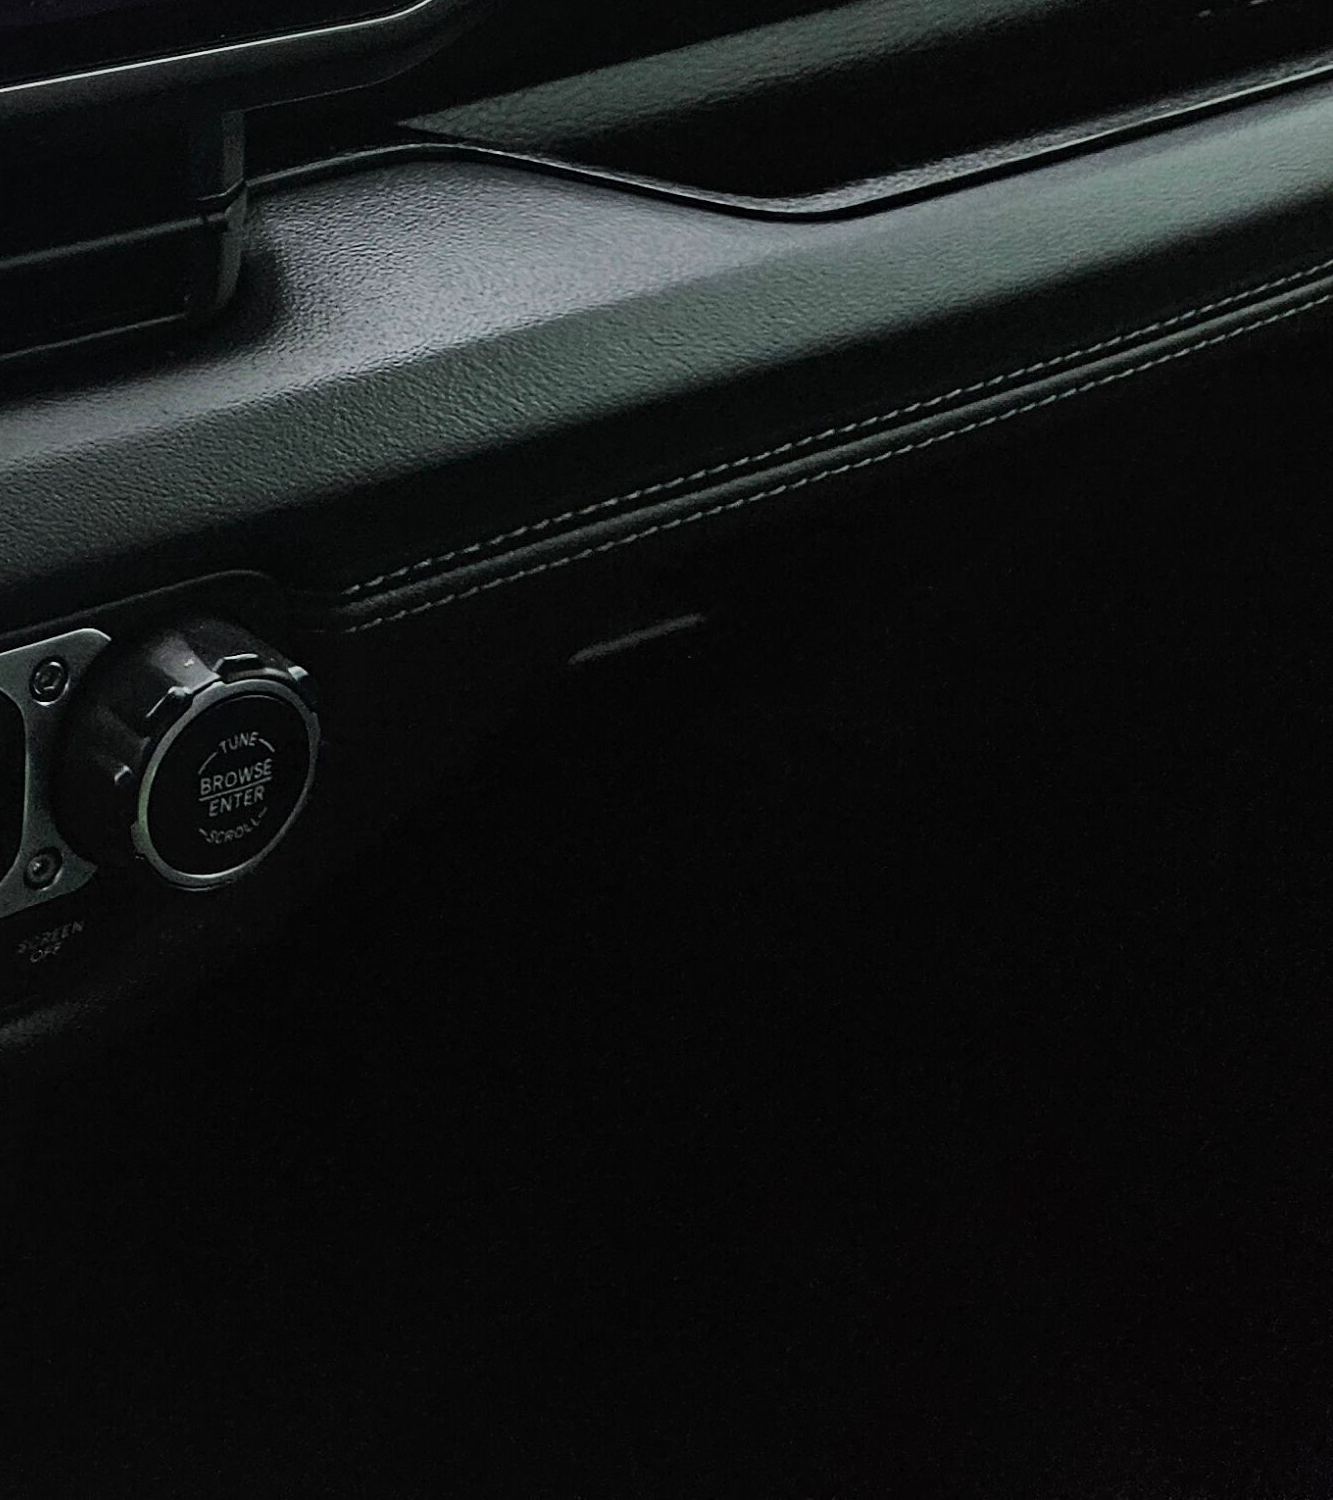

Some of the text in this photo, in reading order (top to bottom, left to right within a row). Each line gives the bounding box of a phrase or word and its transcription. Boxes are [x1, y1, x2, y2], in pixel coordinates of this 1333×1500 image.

[218, 731, 260, 755] TUNE
[199, 757, 274, 797] BROWSE
[208, 785, 266, 817] ENTER
[205, 815, 261, 845] SCROLL
